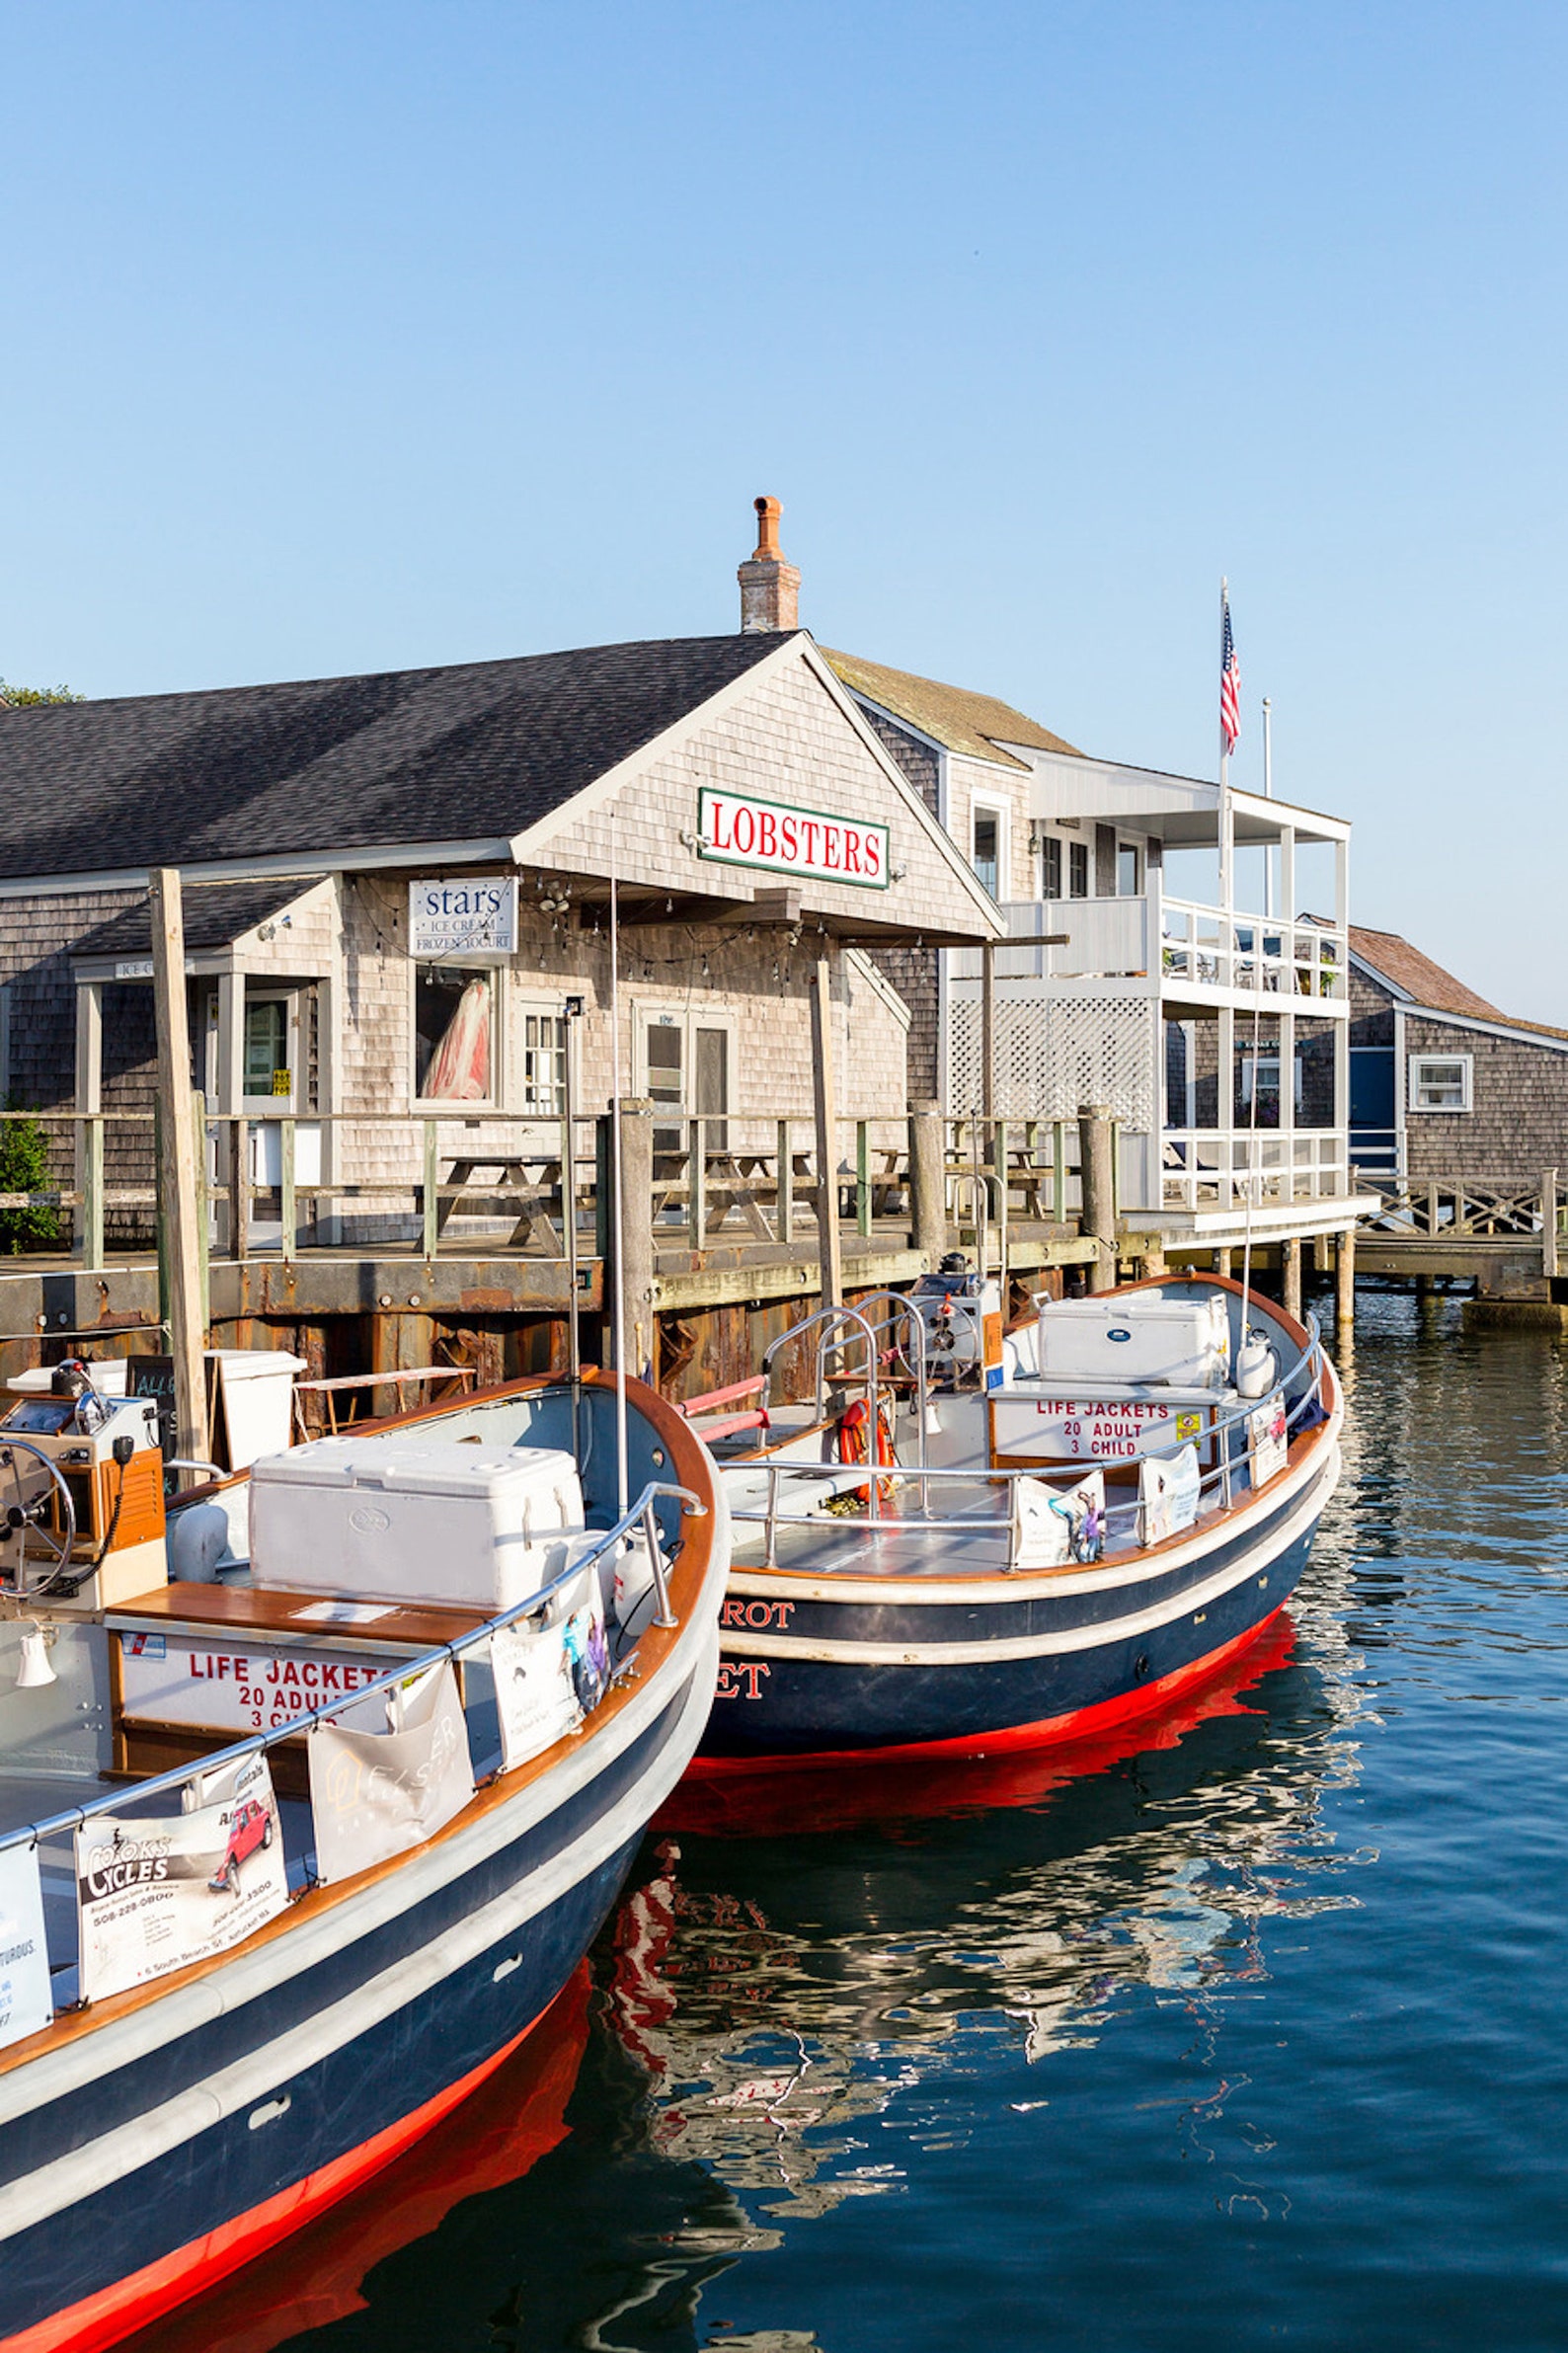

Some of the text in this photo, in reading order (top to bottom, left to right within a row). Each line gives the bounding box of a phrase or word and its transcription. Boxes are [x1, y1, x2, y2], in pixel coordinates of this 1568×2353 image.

[711, 802, 880, 877] LOBSTERS
[426, 889, 501, 916] stars
[431, 918, 496, 933] ICE CREAM
[417, 935, 510, 950] FROZEN YOGURT
[1037, 1400, 1169, 1419] LIFE JACKETS
[1063, 1421, 1141, 1438] 20 ADULT
[1070, 1440, 1136, 1455] 3 CHILD
[190, 1653, 249, 1682] LIFE
[239, 1686, 265, 1706] 20
[251, 1710, 262, 1727] 3
[88, 1858, 168, 1897] CYCLES
